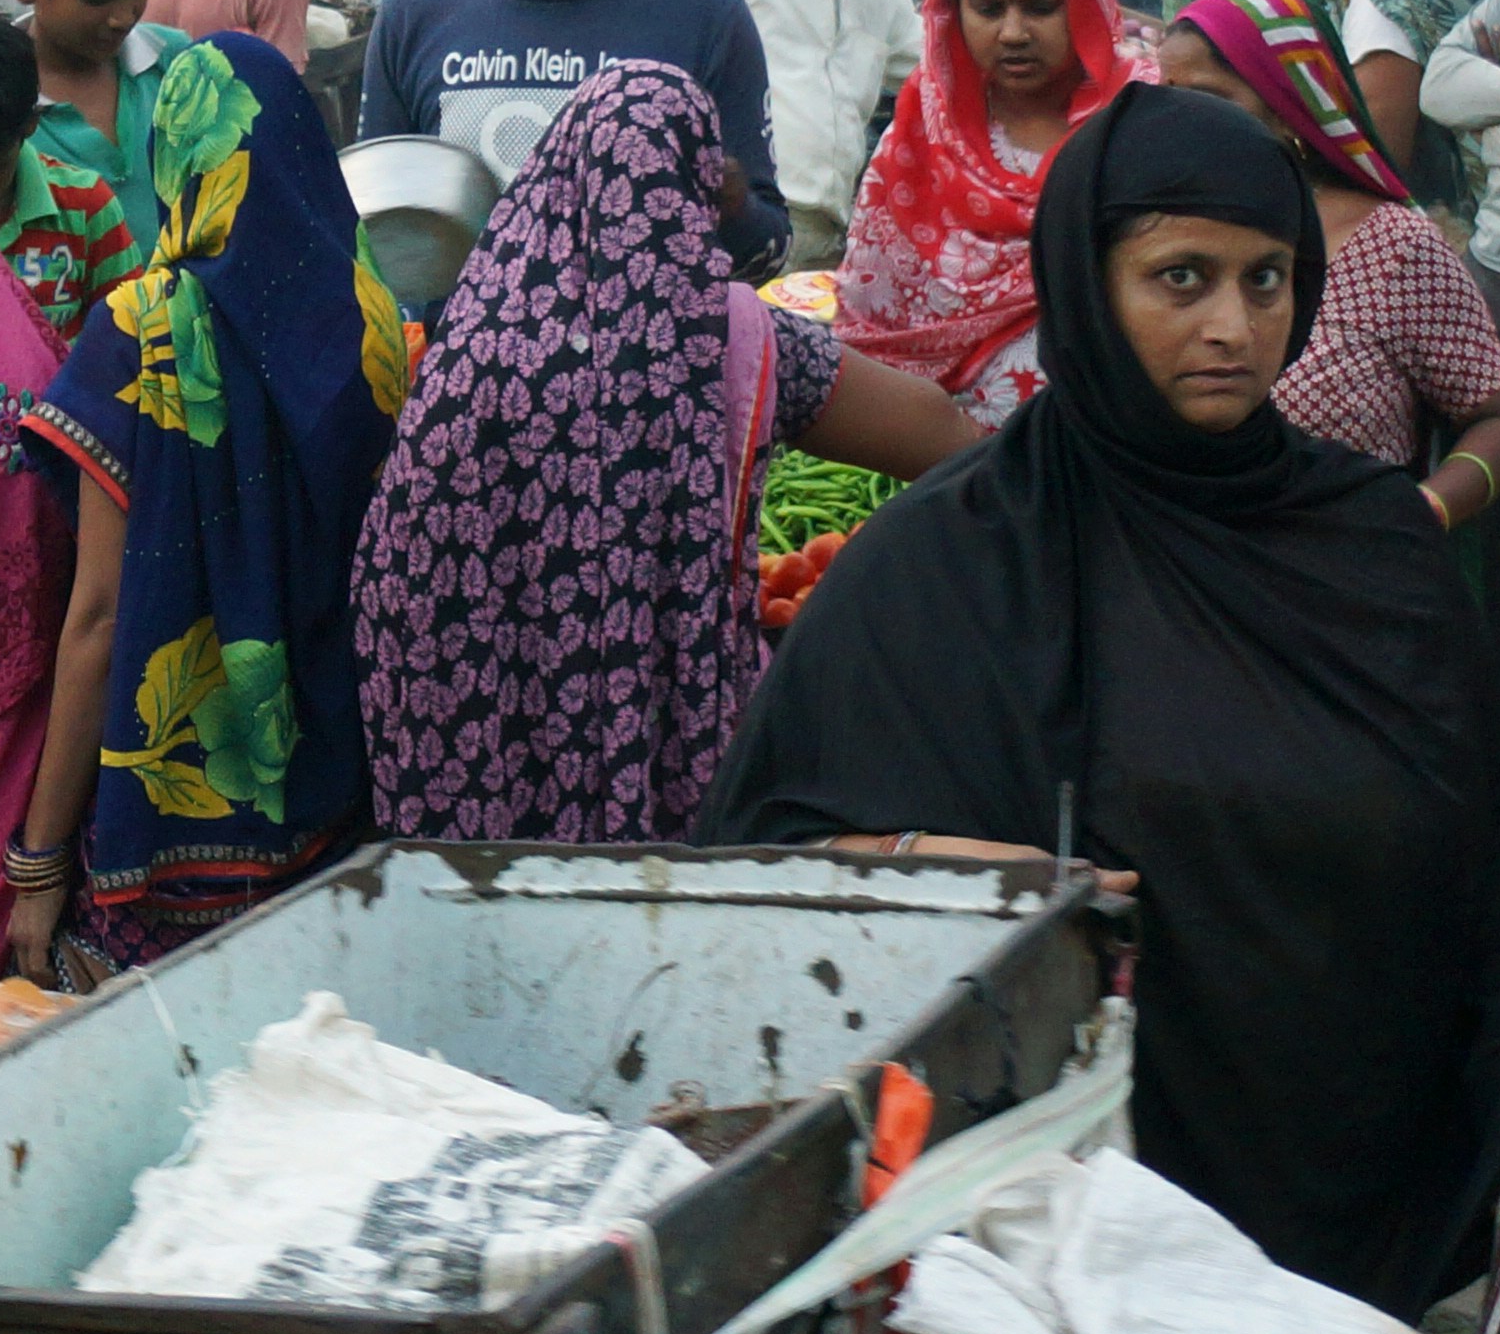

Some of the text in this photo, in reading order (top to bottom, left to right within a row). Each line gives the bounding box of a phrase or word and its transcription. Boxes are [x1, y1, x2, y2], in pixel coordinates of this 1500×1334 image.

[441, 49, 517, 85] Calvin
[524, 47, 586, 82] Klein
[21, 244, 74, 303] 52
